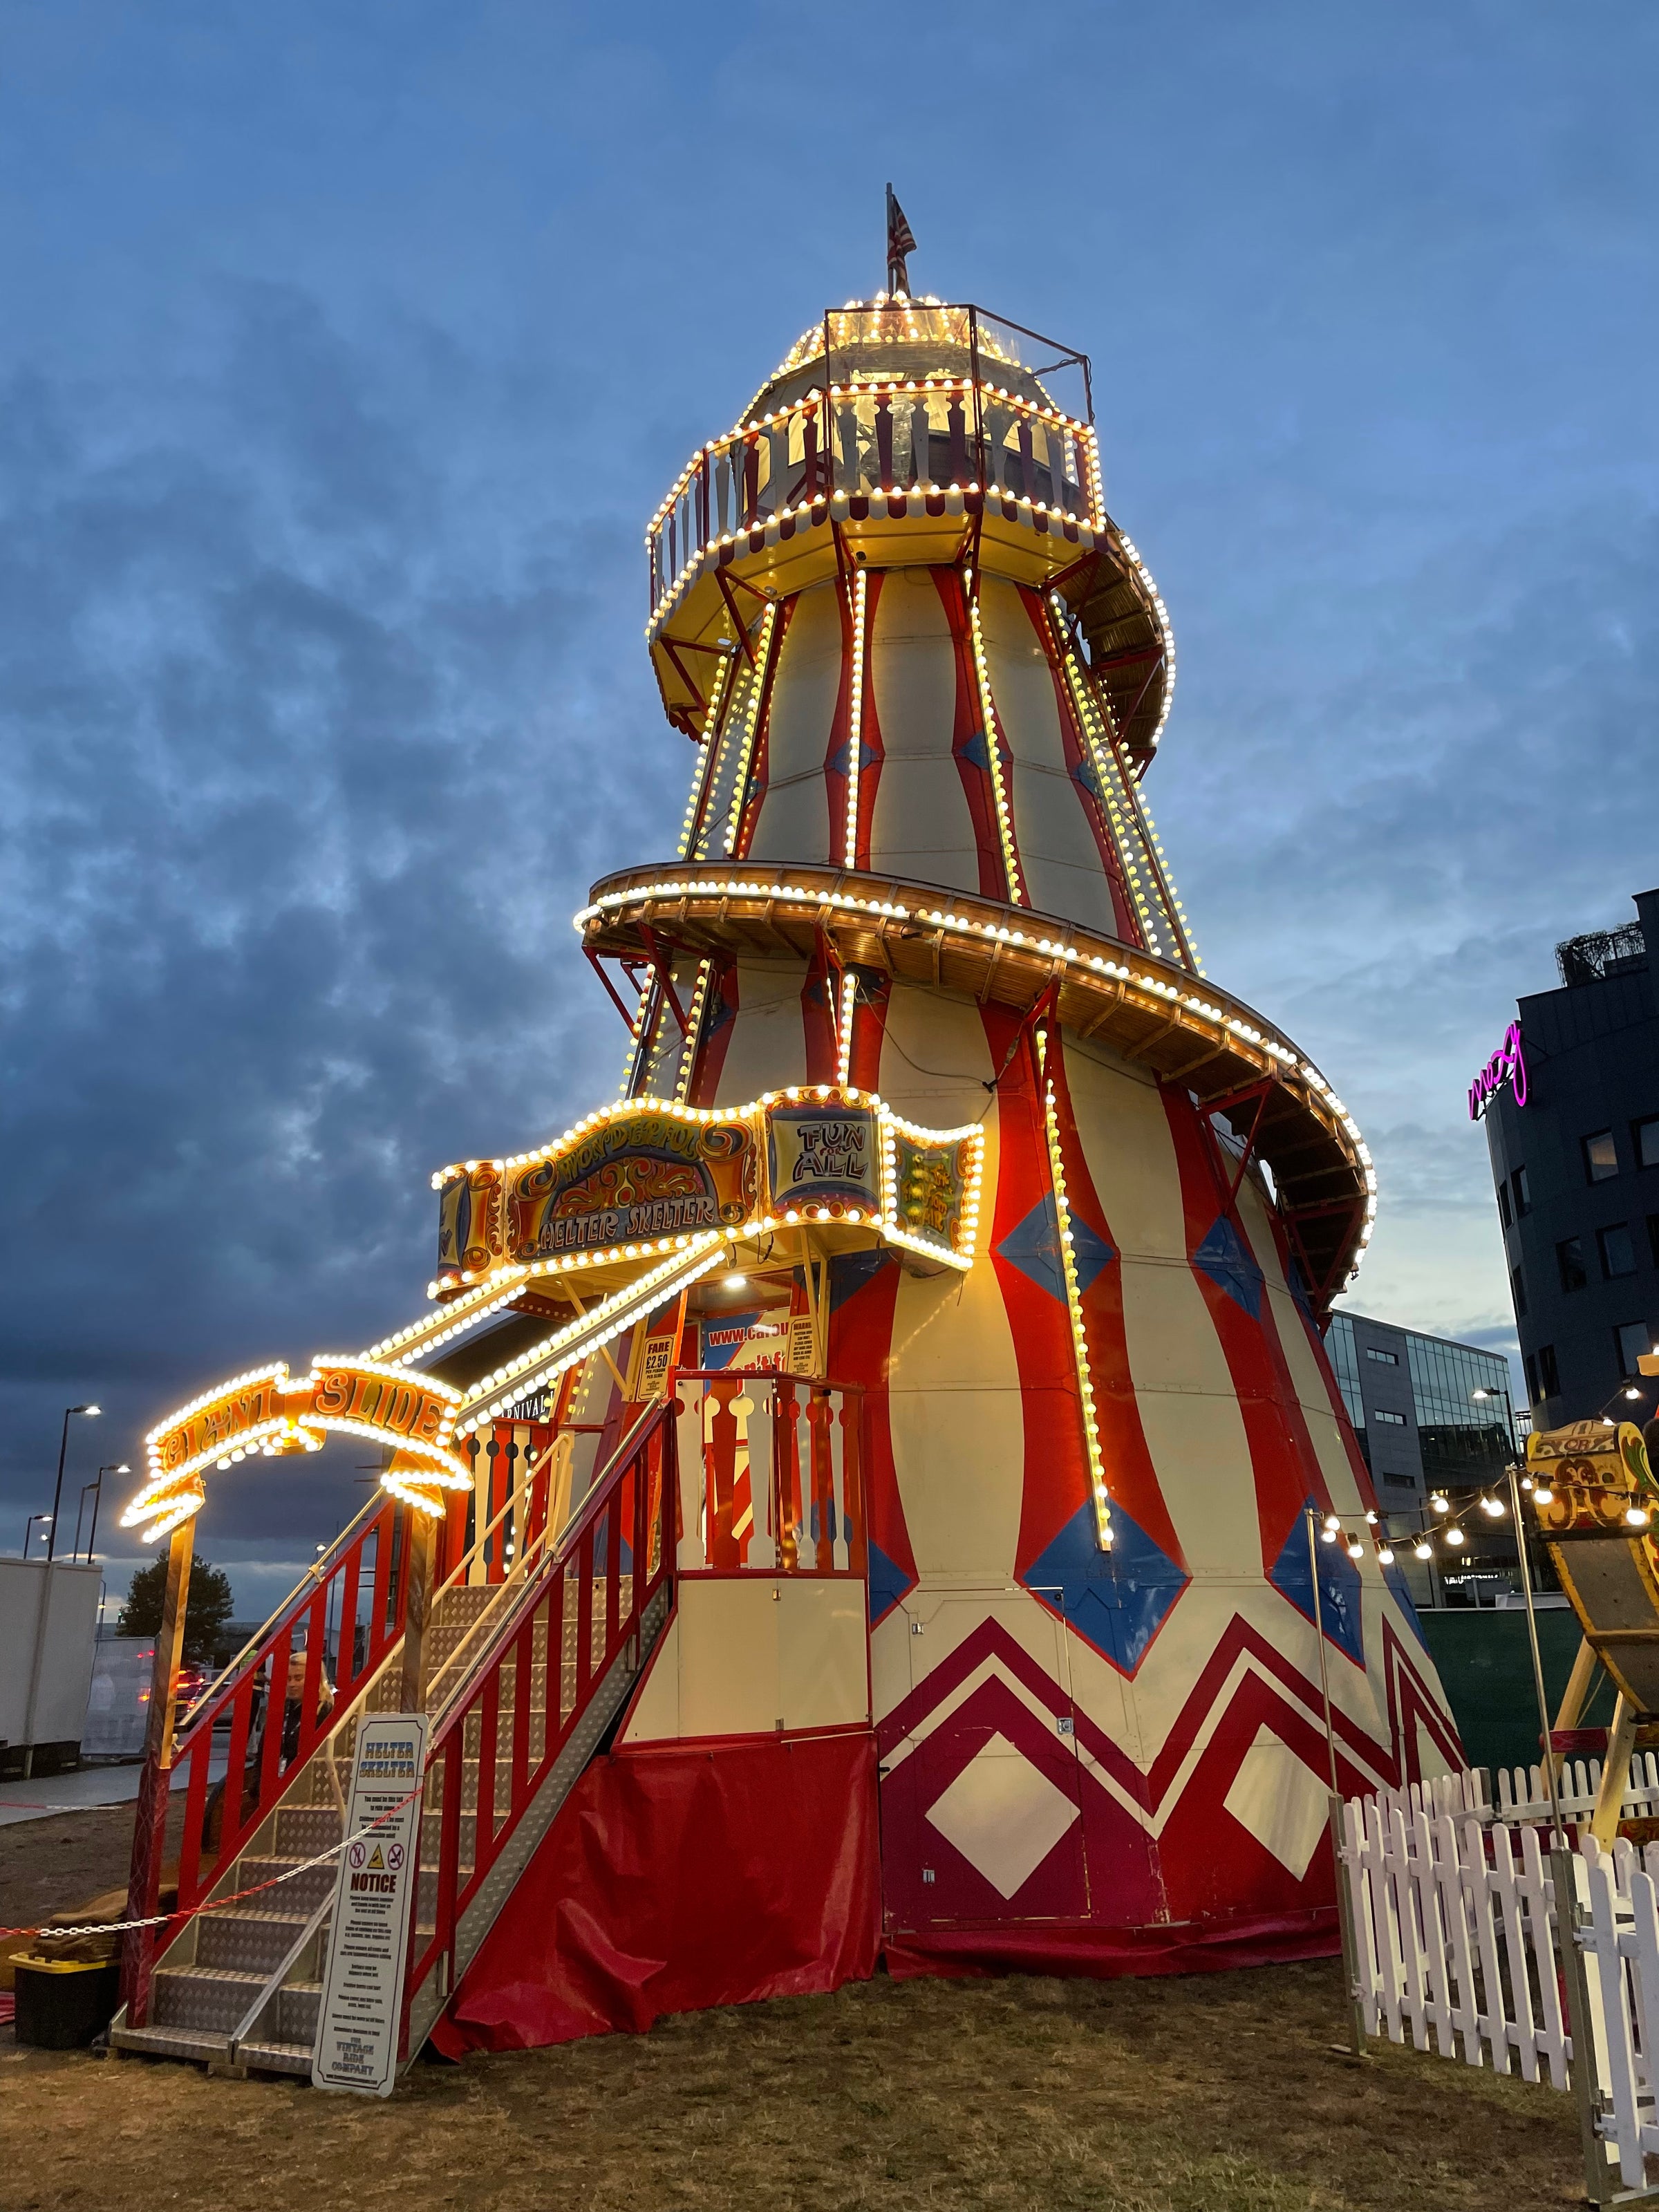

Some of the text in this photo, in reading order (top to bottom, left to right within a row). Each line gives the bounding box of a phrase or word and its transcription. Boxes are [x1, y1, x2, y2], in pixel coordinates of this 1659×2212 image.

[797, 1123, 866, 1152] FUN
[792, 1150, 869, 1183] ALL
[540, 1196, 715, 1250] HELTER SKELTER
[648, 1341, 670, 1354] FARE
[646, 1354, 668, 1369] £2.50
[501, 1395, 545, 1420] RNIVAL
[163, 1372, 444, 1472] GIANT SLIDE
[365, 1743, 413, 1759] HELTER
[359, 1761, 414, 1778] SKELTER
[350, 1873, 397, 1893] NOTICE
[332, 2061, 374, 2076] COMPANY
